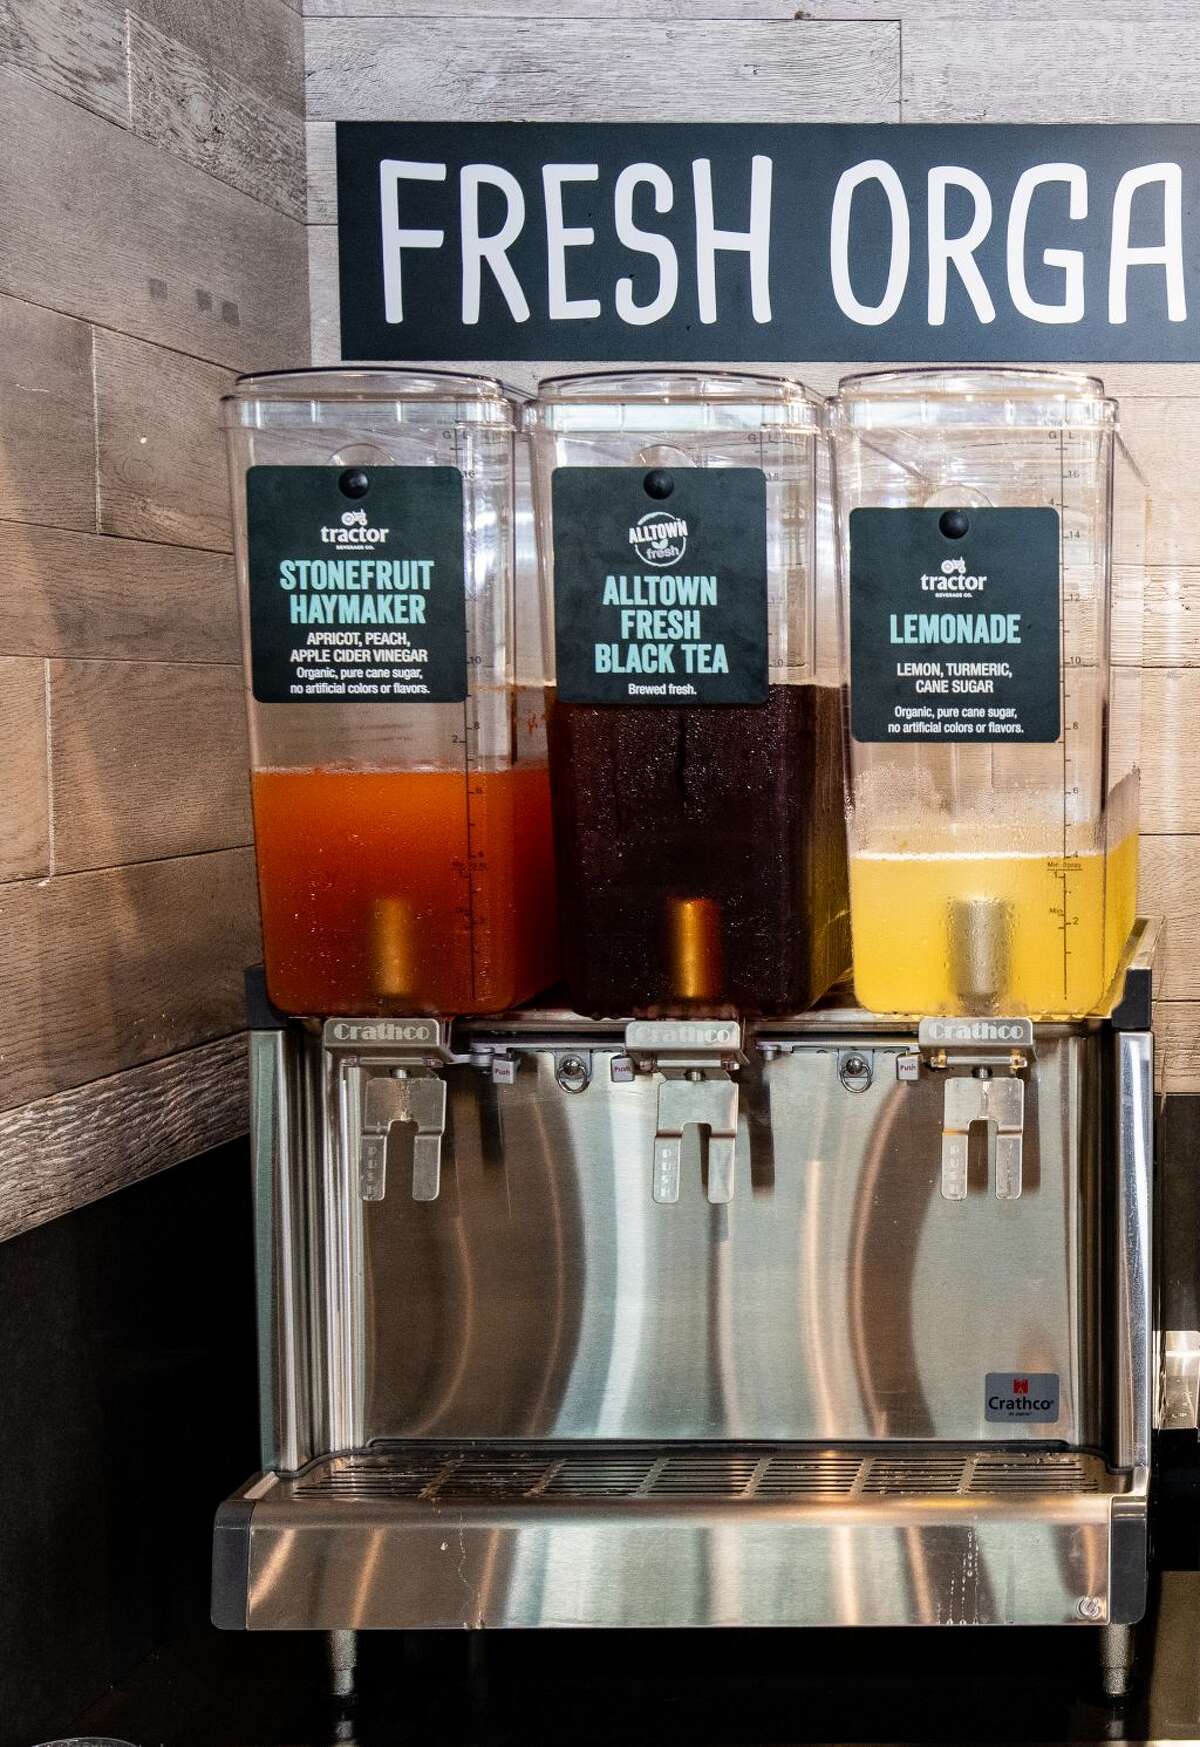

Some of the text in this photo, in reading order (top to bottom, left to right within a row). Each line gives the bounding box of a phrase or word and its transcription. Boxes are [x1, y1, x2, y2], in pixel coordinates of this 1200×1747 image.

[380, 155, 773, 325] FRESH
[320, 525, 389, 543] tractor
[628, 518, 688, 544] ALLTOWN
[1069, 531, 1081, 540] 14
[646, 546, 679, 559] fresh
[280, 560, 435, 590] STONEFRUIT
[920, 574, 987, 591] tractor
[602, 575, 717, 606] ALLTOWN
[1069, 593, 1081, 602] 12
[290, 594, 426, 624] HAYMAKER
[621, 609, 701, 639] FRESH
[890, 614, 1021, 644] LEMONADE
[306, 632, 411, 647] APRICOT, PEACH,
[290, 649, 428, 662] APPLE CIDER VINEGAR
[595, 643, 729, 673] BLACK TEA
[1070, 656, 1081, 665] 10
[296, 667, 423, 680] Organic, pure cane sugar,
[897, 663, 1012, 678] LEMON, TURMERIC,
[290, 683, 430, 694] no artificial colors or flavors.
[628, 683, 697, 695] Brewed fresh.
[916, 679, 994, 693] CANE SUGAR
[894, 706, 1017, 720] Organic, pure cane sugar,
[888, 721, 1024, 733] no artificial colors or flavors.
[1072, 721, 1079, 730] 8
[1072, 787, 1079, 795] 6
[1072, 916, 1080, 925] 2
[334, 1023, 430, 1040] Crathco
[928, 1022, 1024, 1040] Crathco
[900, 1063, 917, 1071] Push
[988, 1396, 1051, 1410] Crathco
